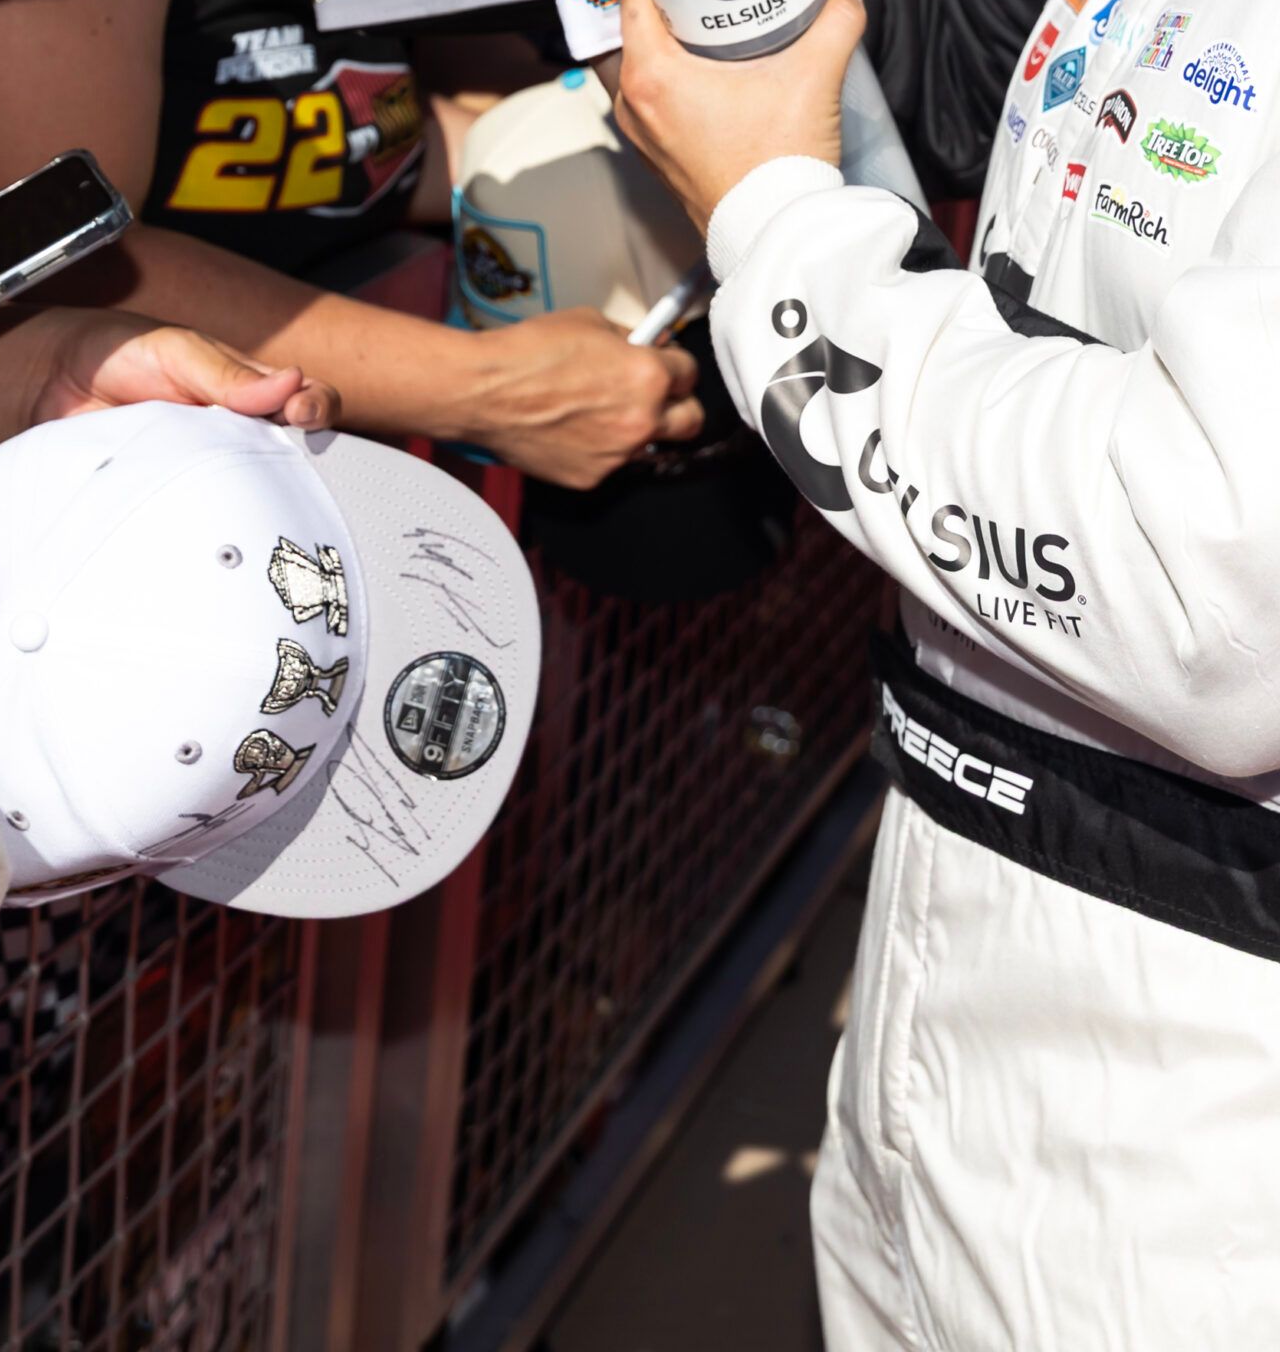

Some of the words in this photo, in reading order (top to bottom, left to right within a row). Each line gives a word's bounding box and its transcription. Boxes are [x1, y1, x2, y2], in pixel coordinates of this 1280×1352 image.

[1183, 58, 1256, 111] delight
[166, 91, 345, 211] 22
[977, 594, 1038, 627] LIVE
[1044, 613, 1083, 639] FIT
